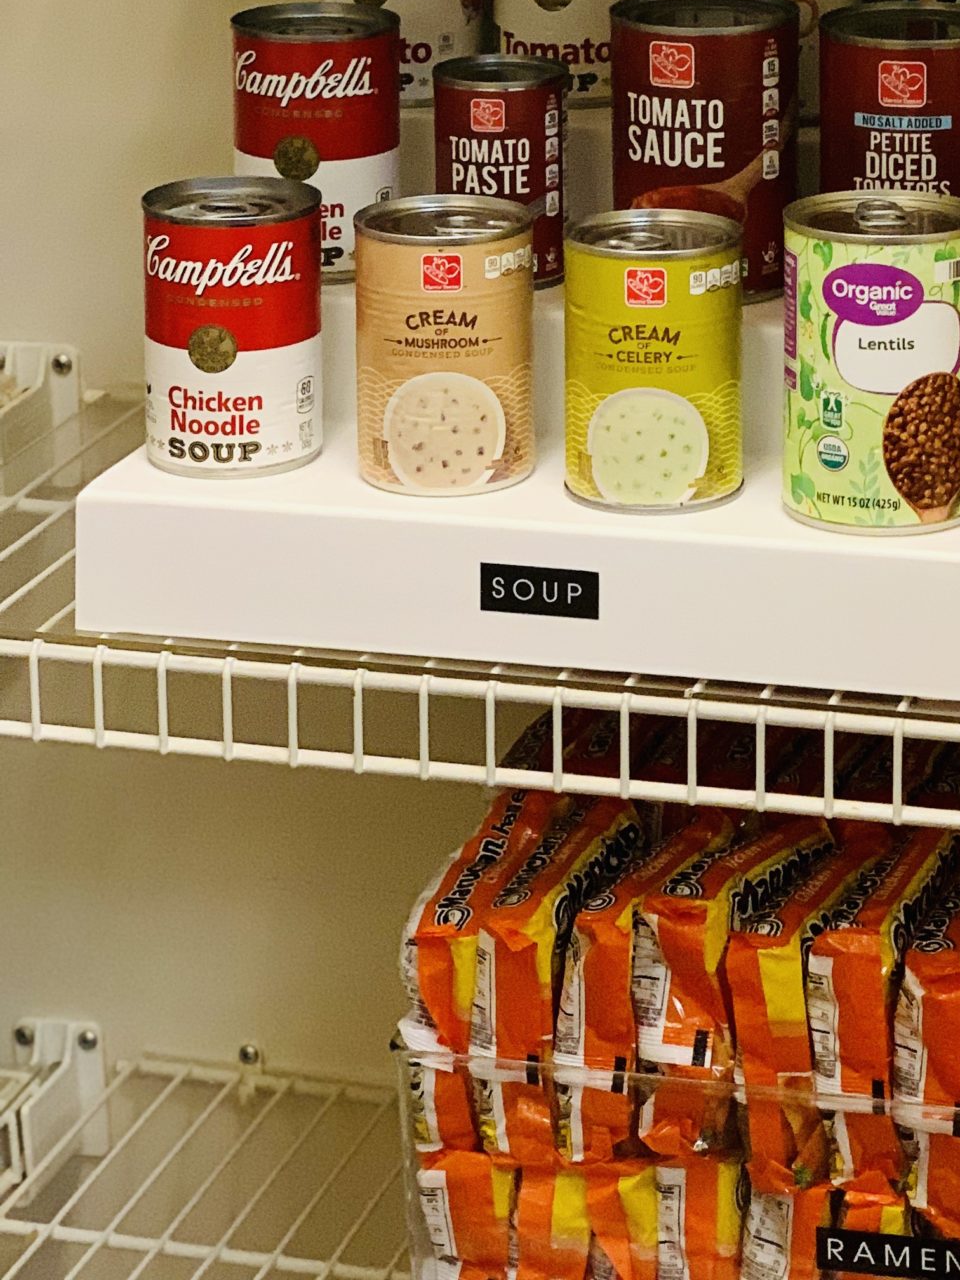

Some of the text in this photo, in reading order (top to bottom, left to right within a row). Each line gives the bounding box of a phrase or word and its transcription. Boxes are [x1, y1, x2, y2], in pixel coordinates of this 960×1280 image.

[235, 50, 374, 107] Campbell's
[627, 91, 724, 130] TOMATO
[862, 115, 942, 129] NO SALT ADDED
[449, 135, 529, 164] TOMATO
[628, 126, 725, 168] SAUCE
[870, 133, 931, 153] PETITE
[865, 153, 937, 181] DICED
[452, 163, 530, 195] PASTE
[146, 235, 298, 296] Campbell's
[831, 279, 913, 304] Organic
[869, 301, 896, 314] Great
[405, 309, 479, 331] CREAM
[435, 327, 449, 336] OF
[404, 336, 480, 349] MUSHROOM
[608, 325, 681, 346] CREAM
[637, 342, 651, 350] OF
[858, 337, 915, 352] Lentils
[616, 350, 673, 364] CELERY
[168, 385, 263, 411] Chicken
[170, 409, 261, 436] Noodle
[168, 437, 262, 463] SOUP
[824, 443, 841, 452] USDA
[816, 492, 901, 512] NET WT 15 OZ (425g)
[492, 577, 582, 604] SOUP
